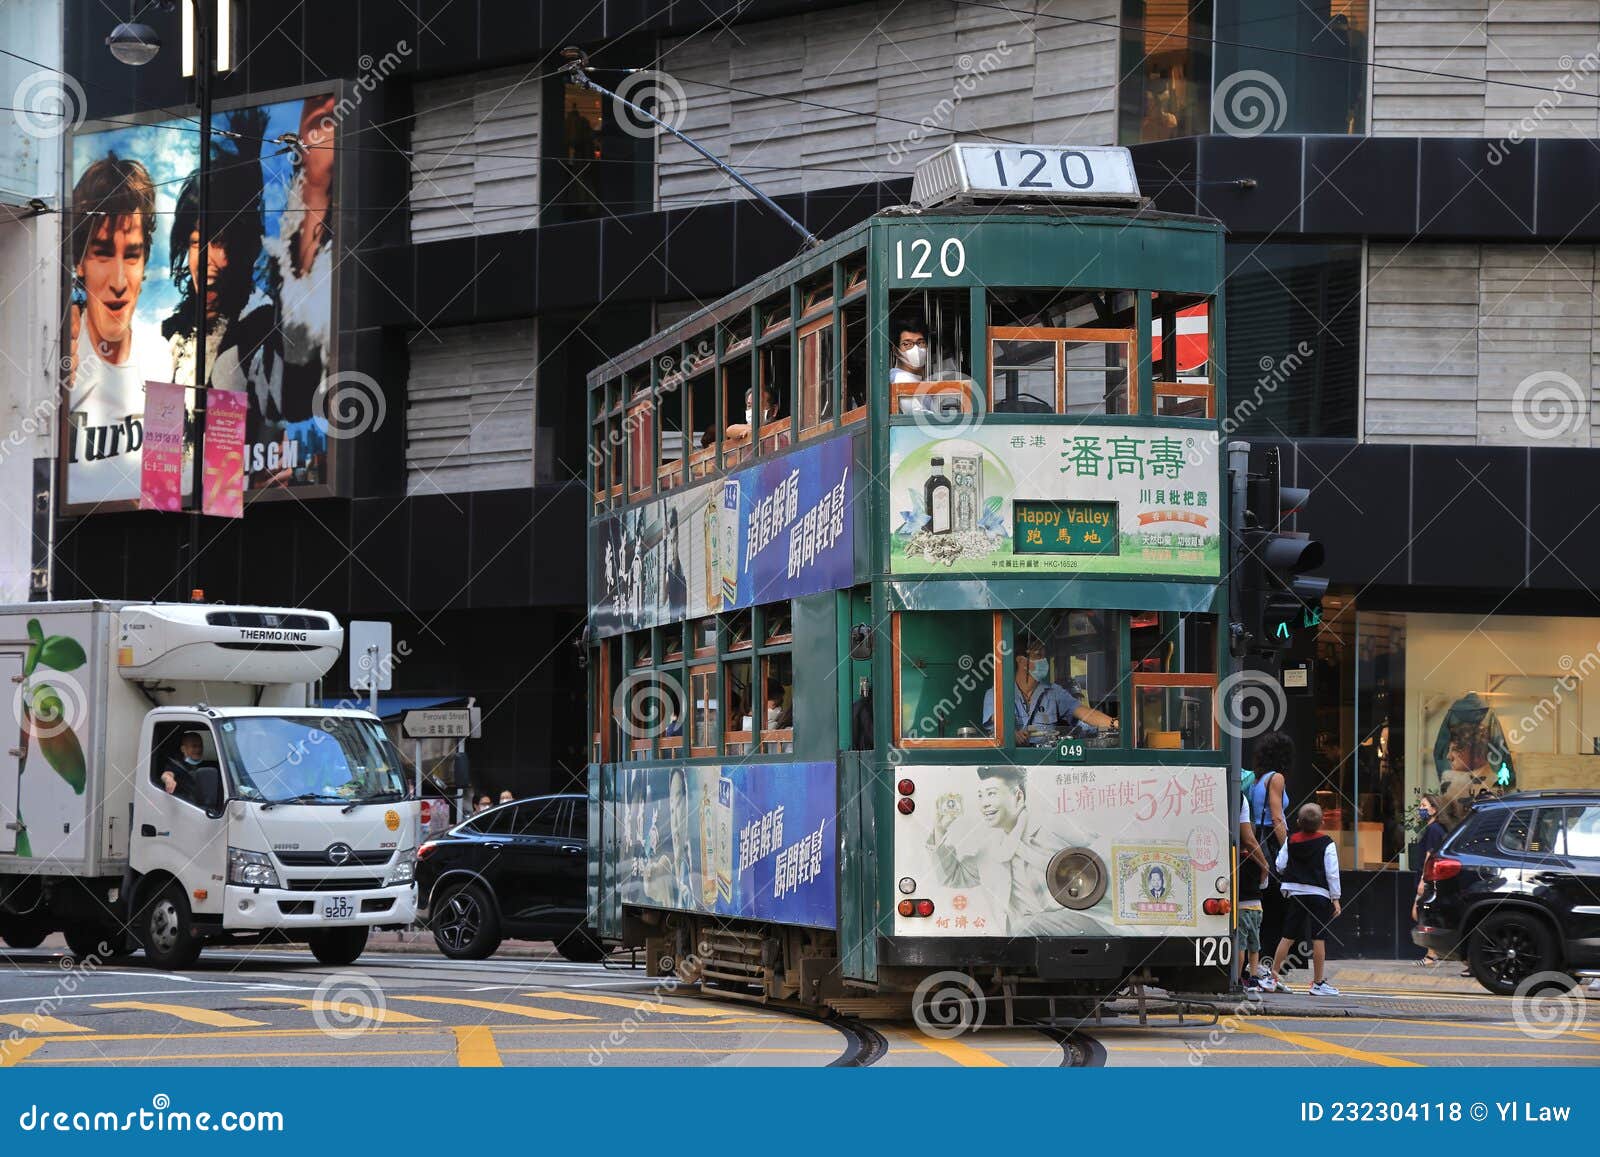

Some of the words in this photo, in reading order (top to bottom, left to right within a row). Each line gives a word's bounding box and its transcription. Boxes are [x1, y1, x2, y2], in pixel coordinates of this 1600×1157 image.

[994, 149, 1094, 189] 120
[896, 237, 966, 280] 120
[1010, 435, 1046, 448] 香港
[1140, 489, 1208, 507] 川貝枇杷露
[1016, 507, 1061, 526] Happy
[1067, 507, 1110, 528] Valley
[1026, 528, 1102, 545] 跑馬地
[240, 629, 282, 641] THERMO
[284, 631, 307, 642] KING
[1060, 745, 1083, 757] 049
[1056, 772, 1217, 822] 止痛唔使5分鐘
[332, 896, 347, 909] TS
[325, 907, 354, 919] 9207
[1195, 936, 1232, 967] 120
